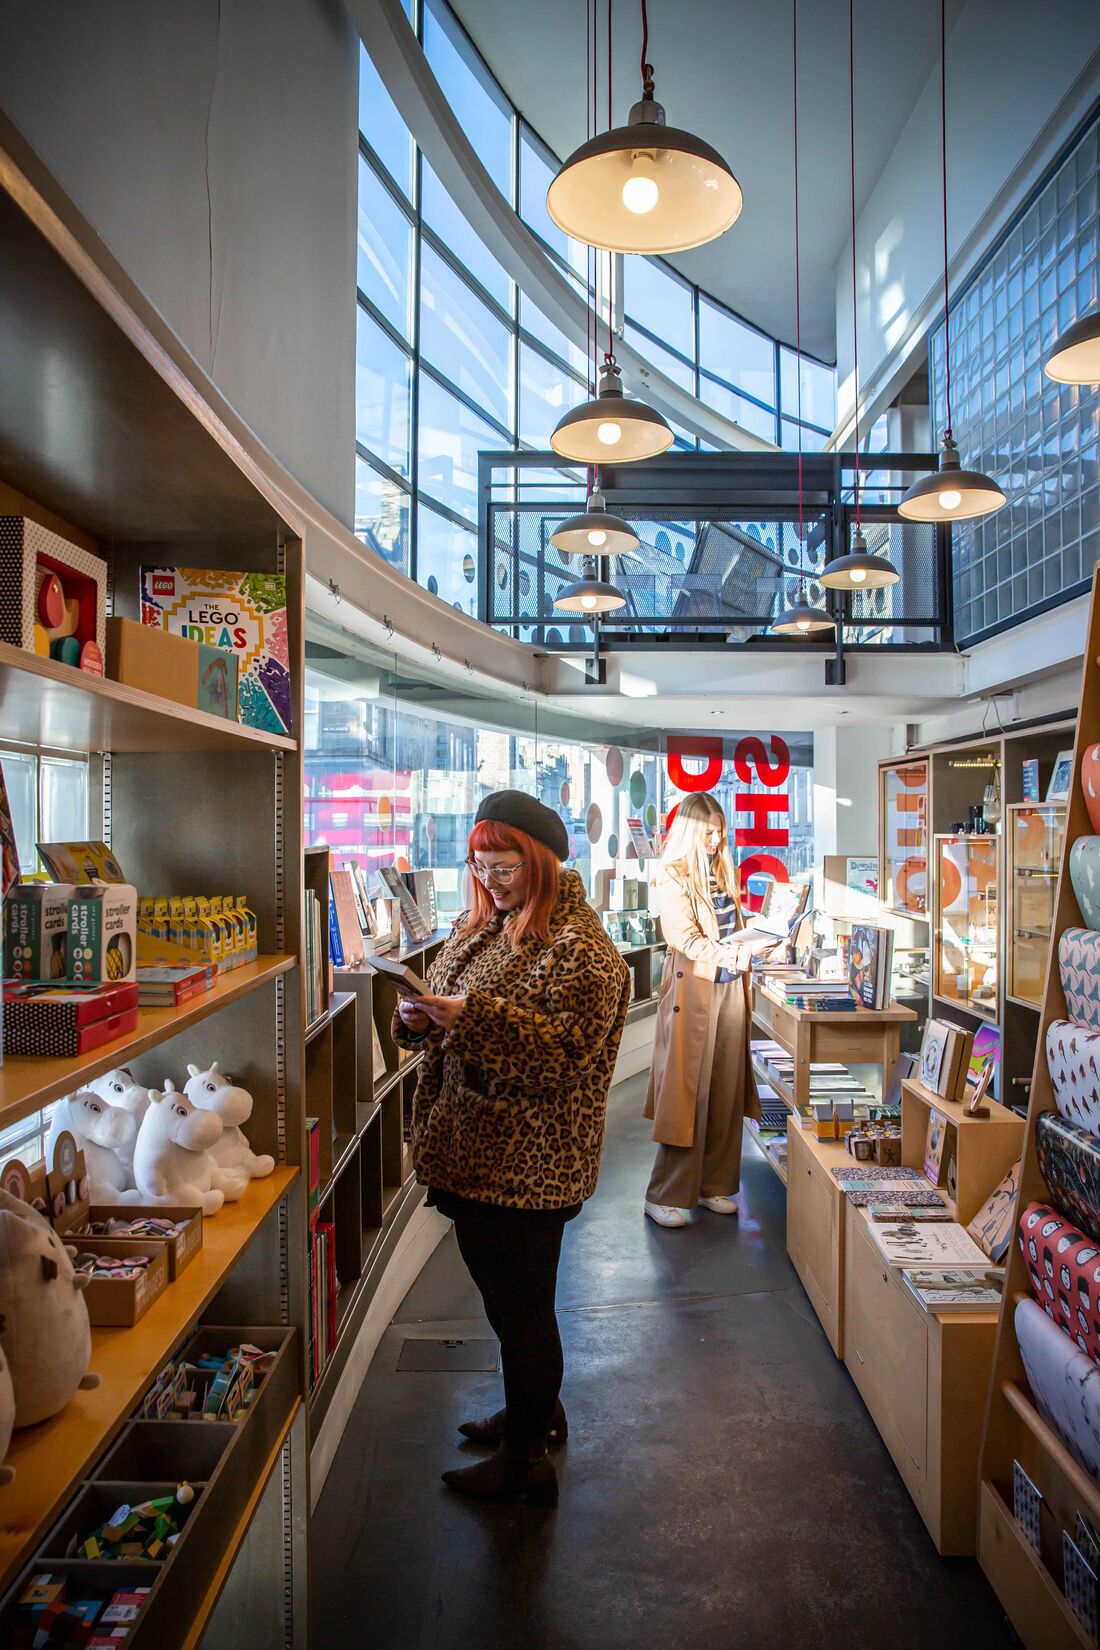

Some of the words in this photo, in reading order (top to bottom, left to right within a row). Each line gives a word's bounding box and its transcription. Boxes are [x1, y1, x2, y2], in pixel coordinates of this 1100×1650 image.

[155, 581, 173, 590] LEGO
[189, 610, 239, 625] LEGO
[181, 625, 247, 649] IDEAS
[45, 902, 68, 917] strolle
[105, 903, 131, 918] stroller
[11, 904, 20, 933] cards
[20, 904, 29, 945] stroller
[45, 917, 65, 930] cards
[71, 904, 80, 935] cards
[80, 905, 89, 947] stroller
[105, 918, 124, 931] cards
